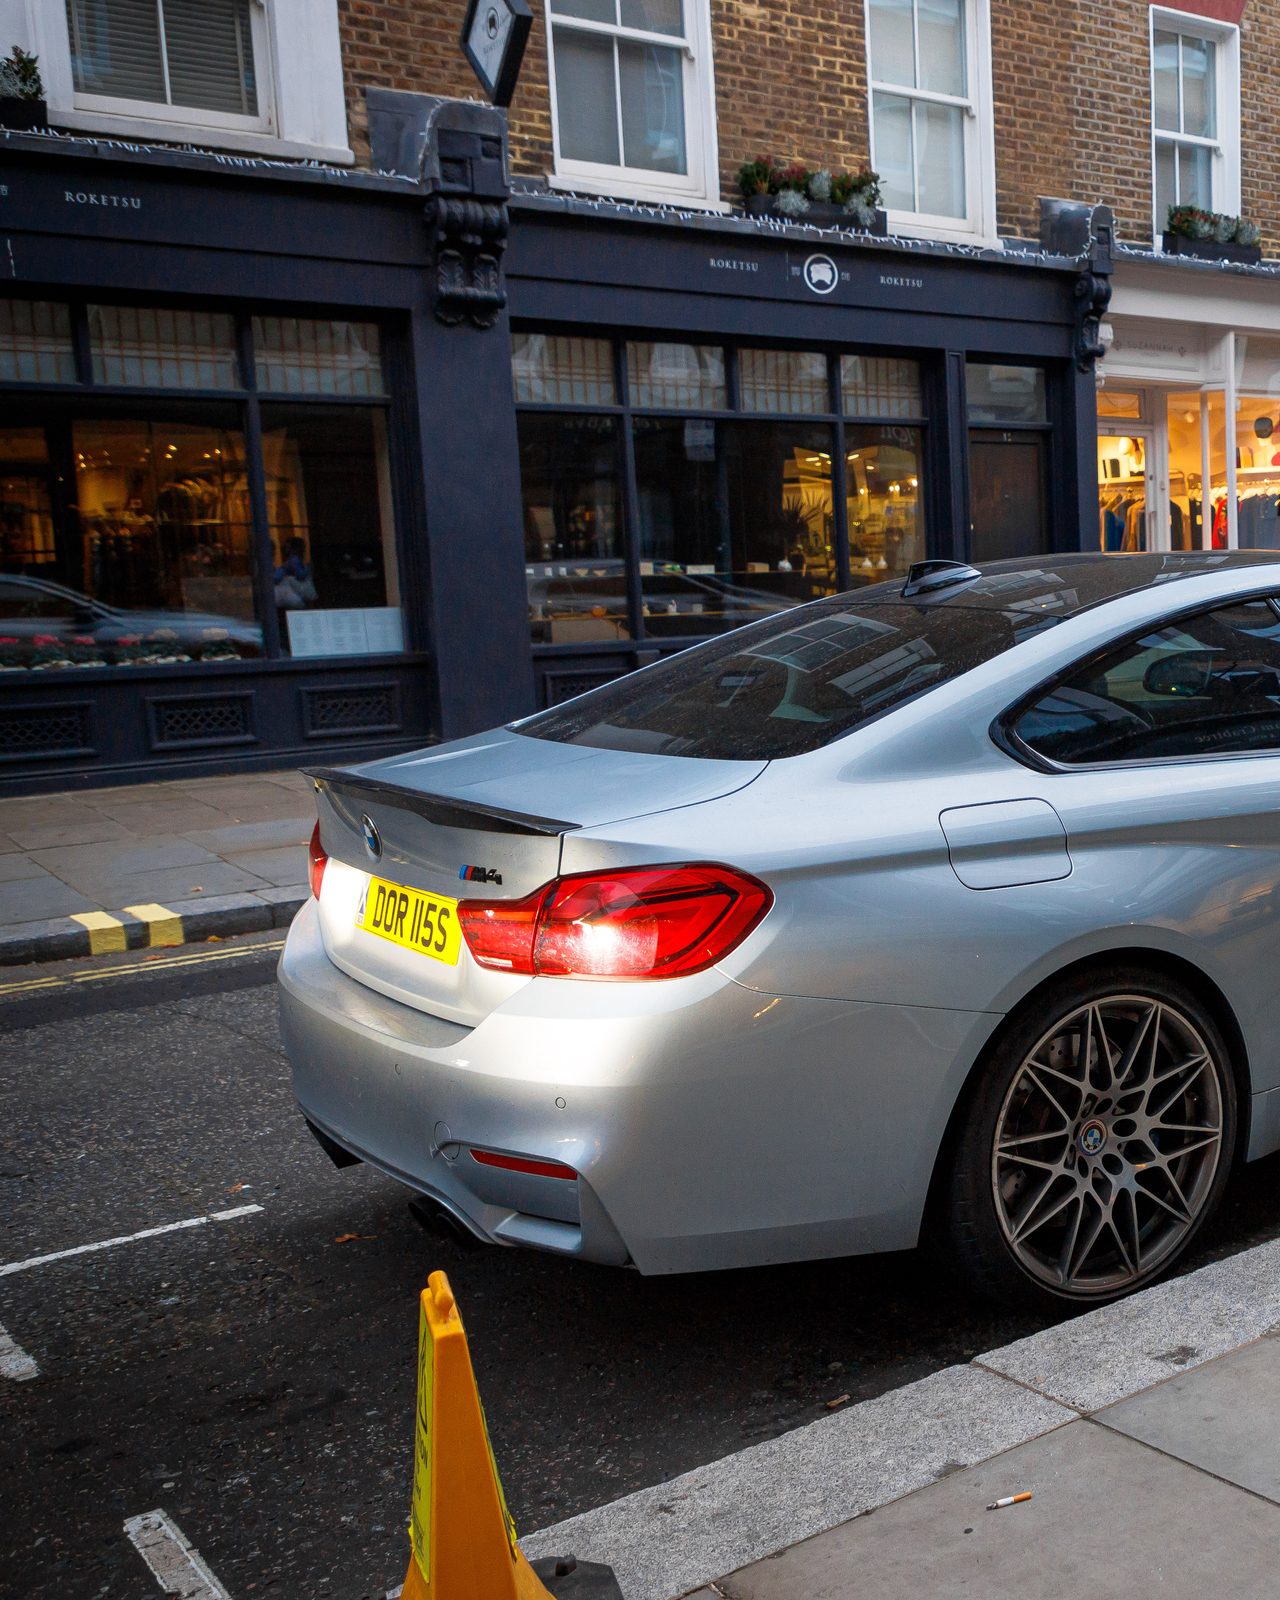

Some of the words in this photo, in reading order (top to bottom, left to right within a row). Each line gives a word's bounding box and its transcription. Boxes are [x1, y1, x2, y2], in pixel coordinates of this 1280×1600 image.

[64, 190, 141, 209] ROKETSU
[709, 258, 759, 272] ROKETSU
[879, 275, 923, 288] ROKETSU
[471, 866, 503, 886] M4
[372, 885, 409, 939] DOR
